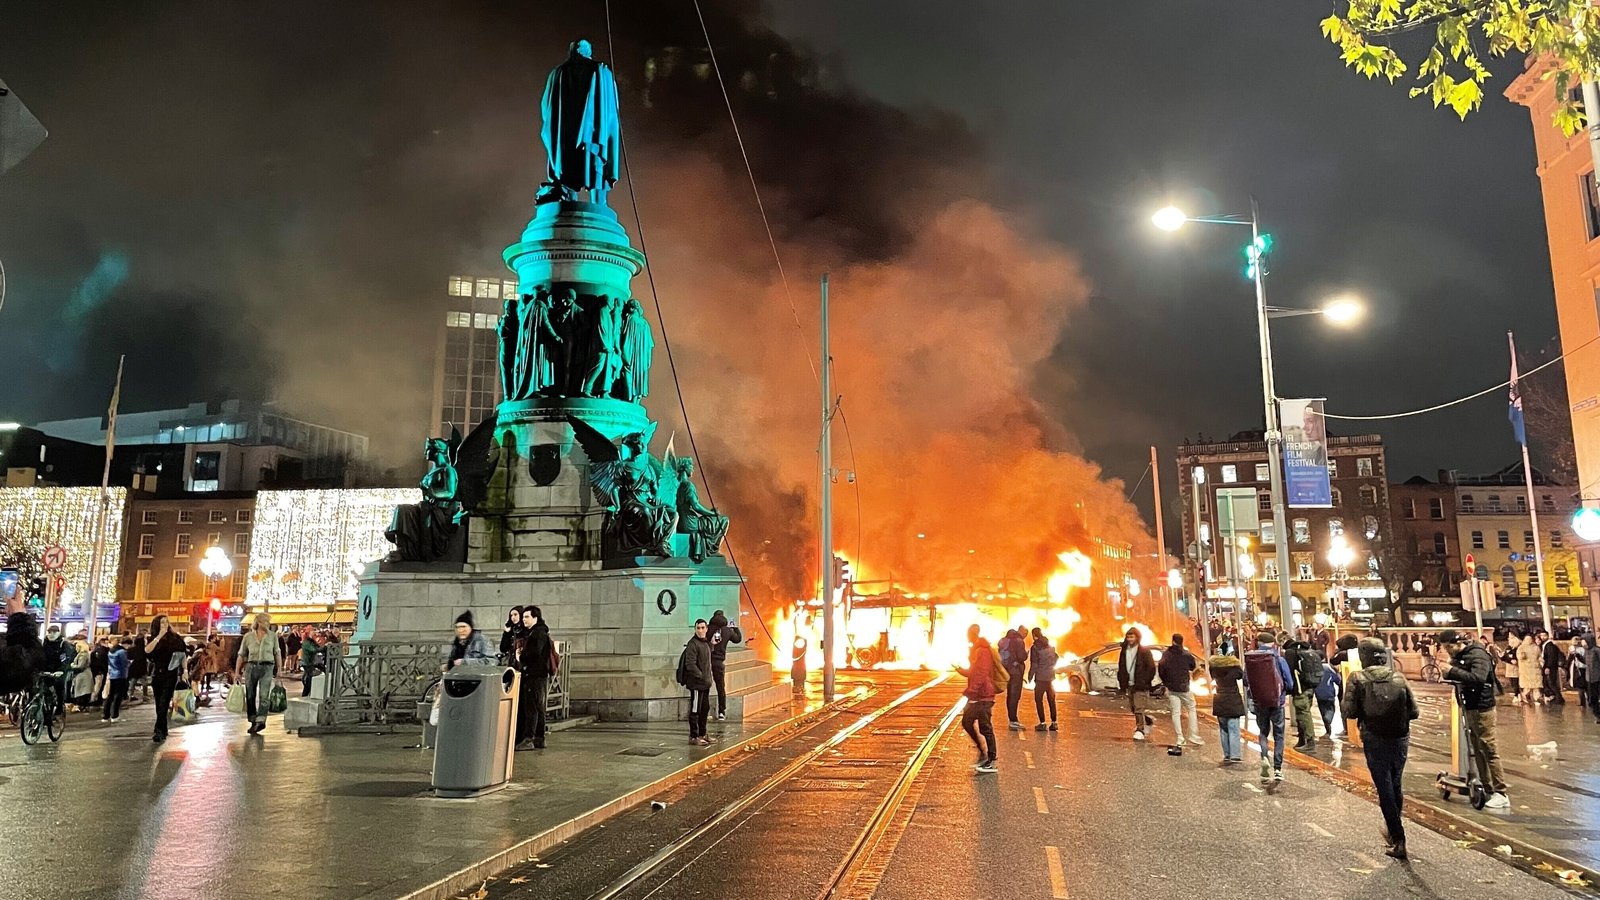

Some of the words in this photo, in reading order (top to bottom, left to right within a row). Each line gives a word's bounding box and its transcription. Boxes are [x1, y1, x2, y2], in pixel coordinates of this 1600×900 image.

[1286, 442, 1312, 450] FRENCH
[1287, 450, 1302, 459] FILM
[1288, 458, 1317, 467] FESTIVAL
